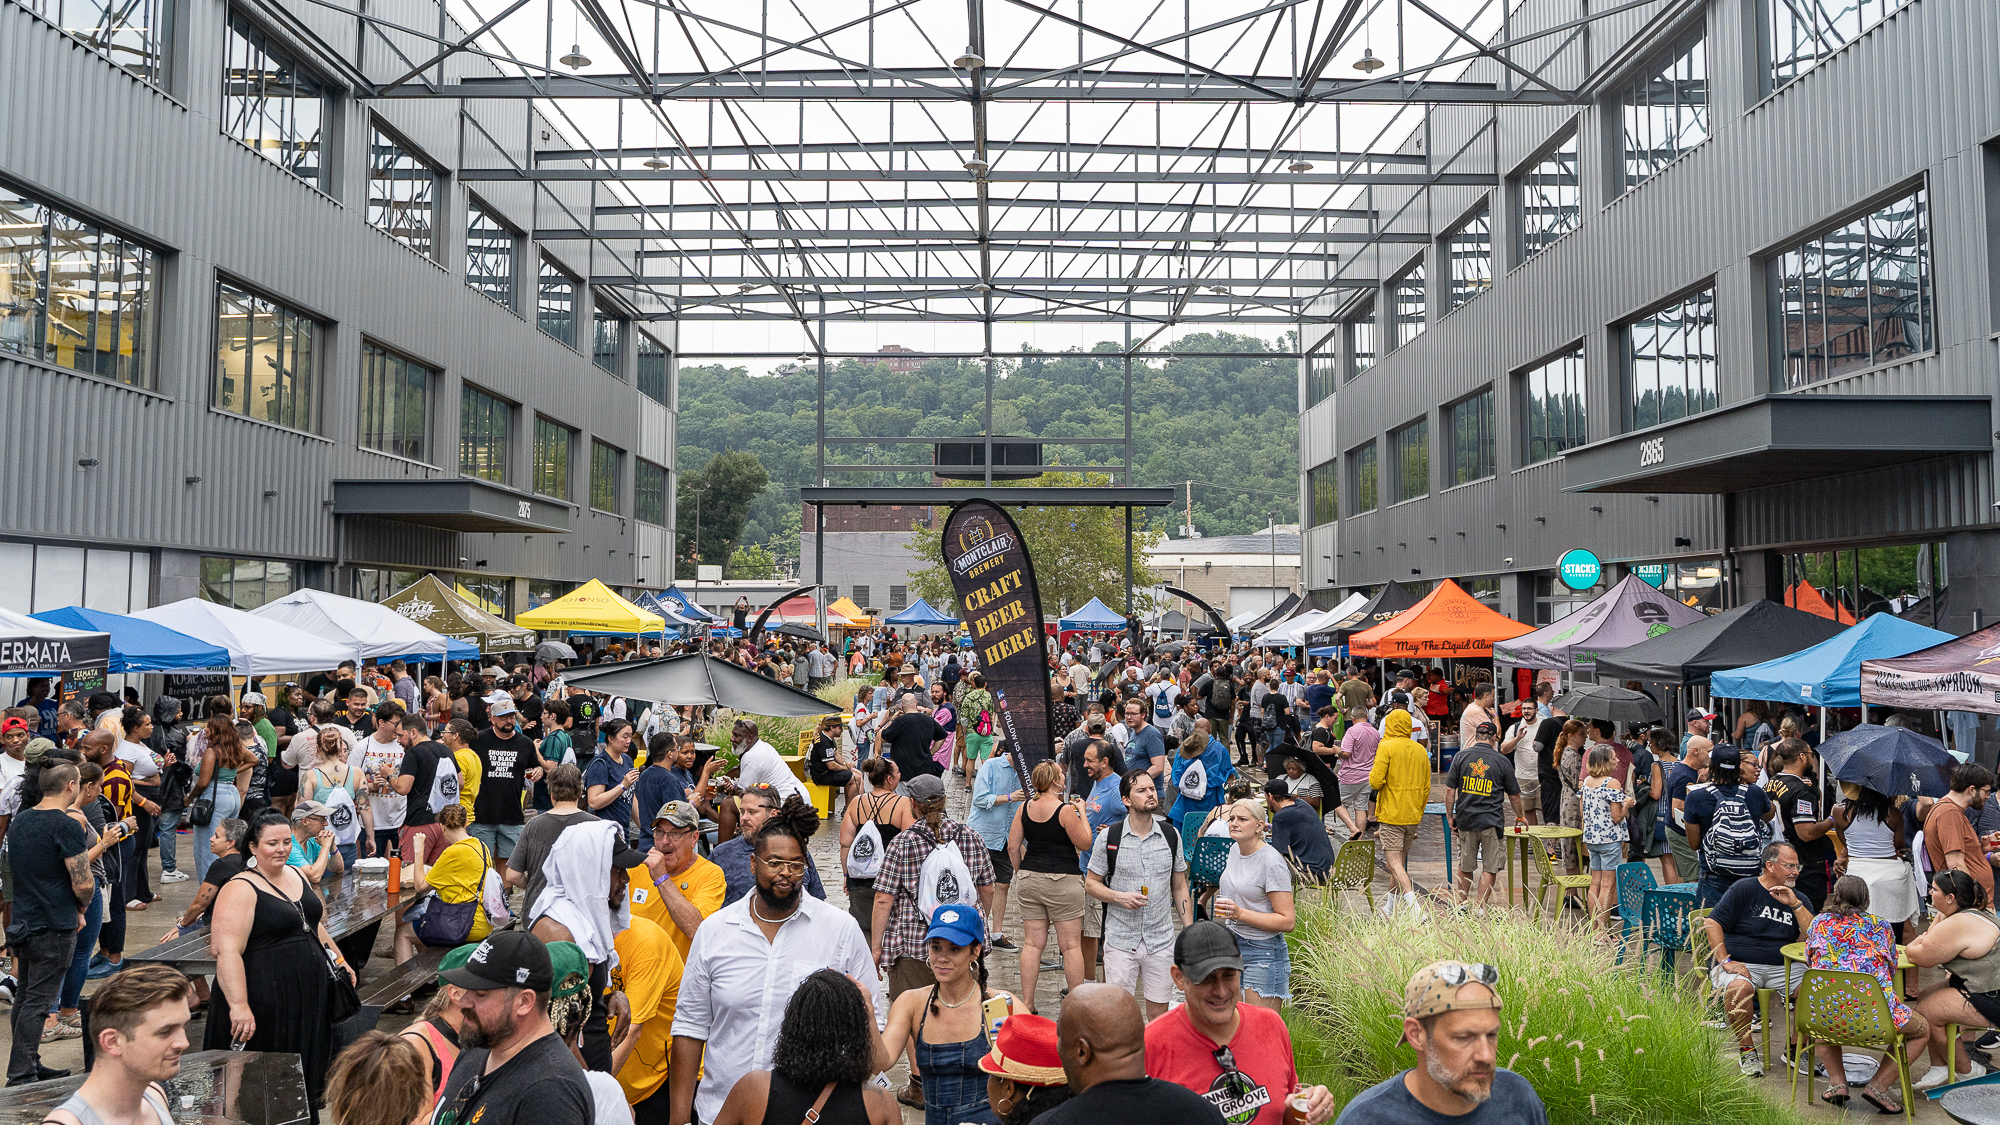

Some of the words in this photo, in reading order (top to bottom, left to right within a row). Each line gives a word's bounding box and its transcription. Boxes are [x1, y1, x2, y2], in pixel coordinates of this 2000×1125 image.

[1640, 436, 1664, 467] 2865
[957, 536, 1008, 570] MONTCLAIR
[968, 554, 1004, 579] BREWERY
[965, 568, 1022, 611] CRAFT
[396, 604, 435, 615] BUTLER
[974, 599, 1026, 637] BEER
[984, 626, 1037, 671] HERE
[1395, 640, 1420, 655] May
[1421, 640, 1440, 651] The
[1440, 639, 1471, 654] Liquid
[1874, 670, 1901, 689] VISIT
[1918, 679, 1932, 691] OUR
[1934, 671, 1983, 694] TAPROOM
[1004, 711, 1017, 740] FOLLOW
[1013, 741, 1021, 752] US
[488, 749, 518, 757] SHOUTOUT
[1221, 1087, 1268, 1114] GROOVE
